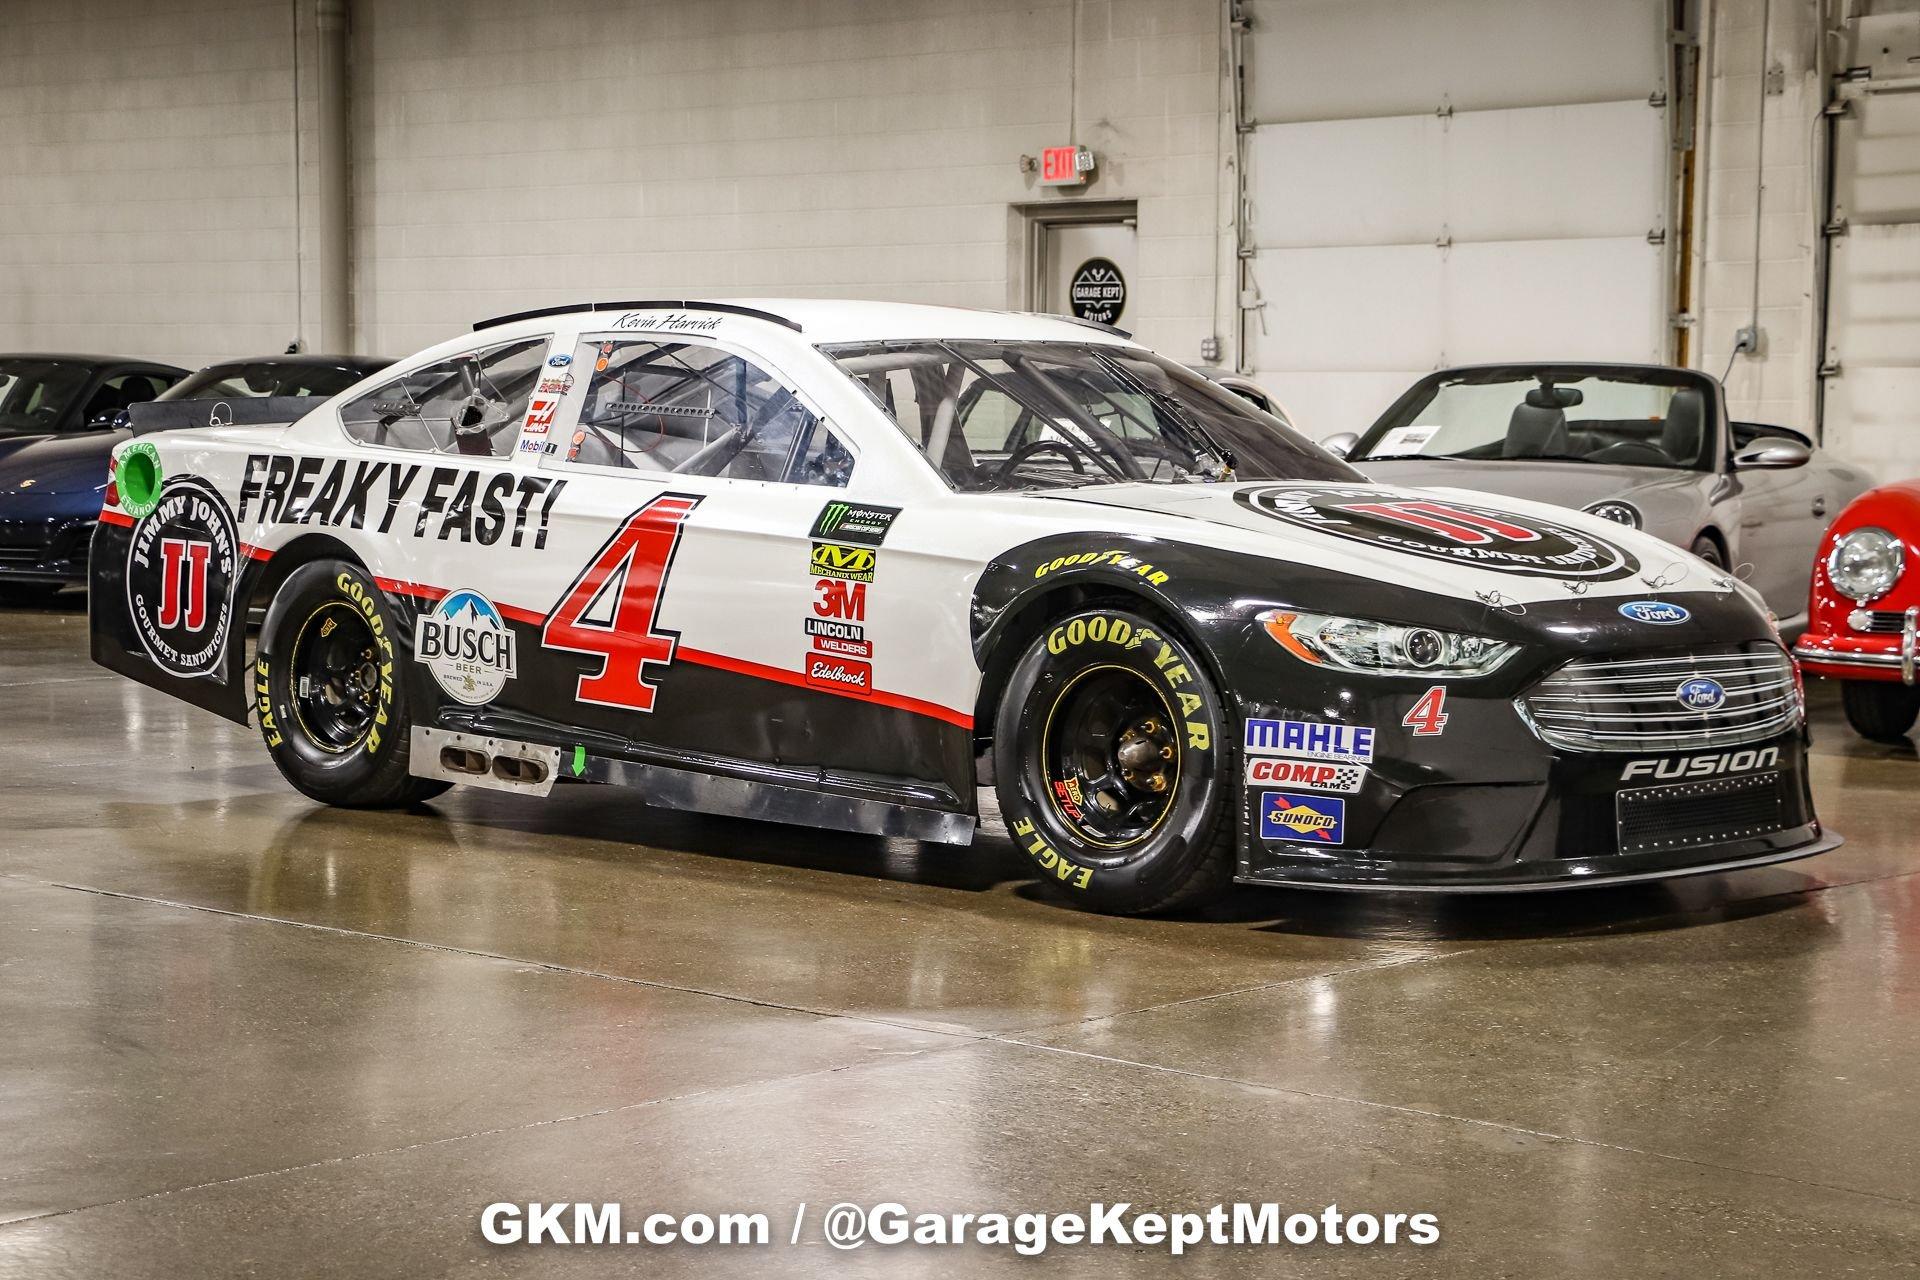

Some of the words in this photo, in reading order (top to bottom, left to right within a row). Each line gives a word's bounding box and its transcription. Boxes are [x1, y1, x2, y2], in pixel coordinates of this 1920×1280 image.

[1043, 148, 1076, 181] EXIT
[1076, 287, 1101, 298] GARAGE
[1102, 287, 1120, 298] KEPT
[1083, 309, 1112, 322] MOTORS
[551, 355, 570, 366] Ford
[119, 443, 160, 470] AMERICAN
[520, 439, 546, 451] Mobil
[121, 496, 155, 516] ETHANOL
[237, 454, 420, 533] FREAKY
[414, 467, 568, 550] FAST!
[134, 496, 187, 568] JIMMY
[190, 496, 232, 575] JOHN'S
[1377, 535, 1546, 564] GOURMET
[810, 564, 850, 580] MECHANIX
[850, 572, 874, 583] WEAR
[1034, 550, 1169, 586] GOODYEAR
[157, 538, 212, 633] JJ
[813, 579, 866, 621] 3M
[540, 491, 707, 713] 4
[1634, 604, 1680, 621] Ford
[135, 594, 178, 662] GOURMET
[180, 602, 228, 667] SANDWICHES
[806, 620, 861, 640] LINCOLN
[420, 621, 514, 672] BUSCH
[820, 639, 868, 655] WELDERS
[336, 572, 393, 754] GOODYEAR
[455, 663, 482, 674] BEER
[811, 662, 866, 686] Edelbrock
[1047, 616, 1210, 751] GOODYEAR
[1688, 684, 1716, 705] Ford
[256, 657, 283, 748] EAGLE
[1402, 686, 1449, 736] 4
[1246, 719, 1373, 757] MAHLE
[1307, 751, 1333, 760] ENGINE
[1333, 752, 1370, 763] BEARINGS
[1620, 747, 1779, 781] FUSION
[1252, 761, 1336, 784] COMP
[1309, 780, 1351, 791] CAMS
[1053, 781, 1083, 820] SETUP
[1272, 811, 1333, 828] SUNOCO
[1013, 816, 1094, 889] EAGLE
